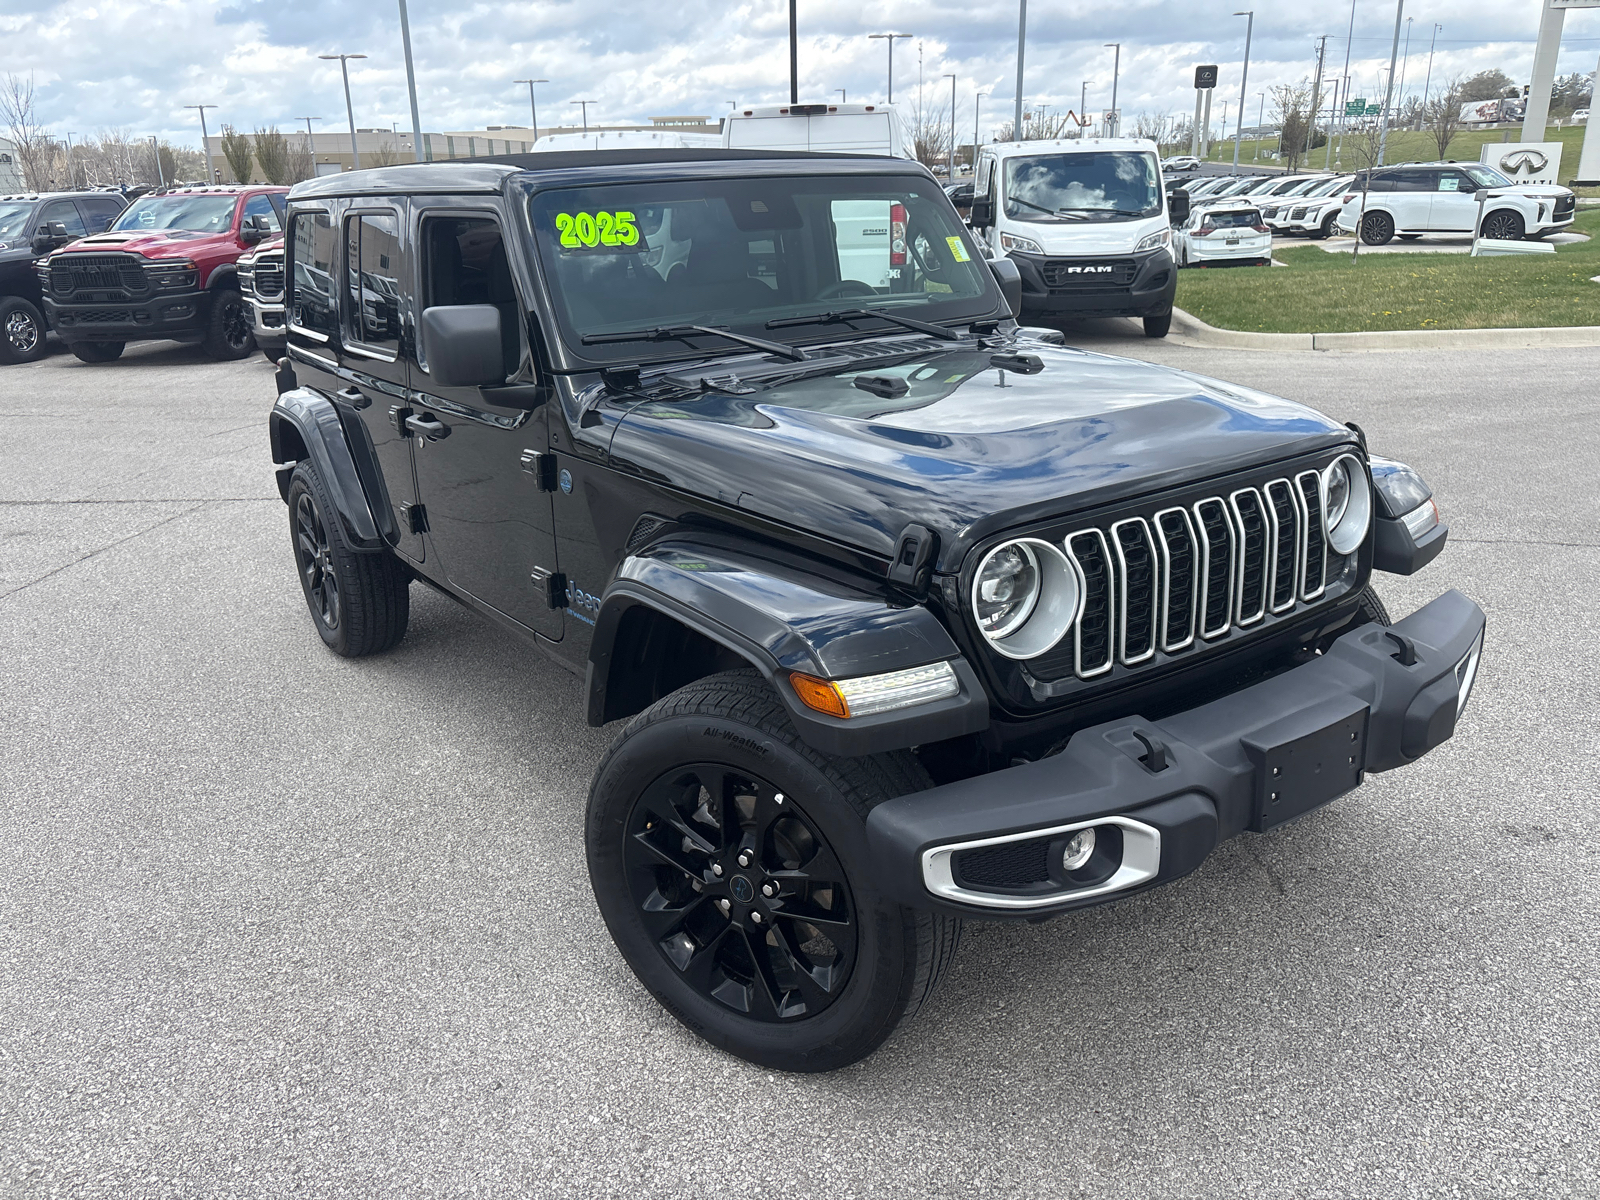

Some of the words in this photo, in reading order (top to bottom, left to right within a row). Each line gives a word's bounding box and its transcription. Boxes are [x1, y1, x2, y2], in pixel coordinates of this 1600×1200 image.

[556, 211, 639, 248] 2025
[1067, 265, 1113, 274] RAM
[565, 580, 601, 620] Jeep
[703, 726, 769, 755] All-Weather
